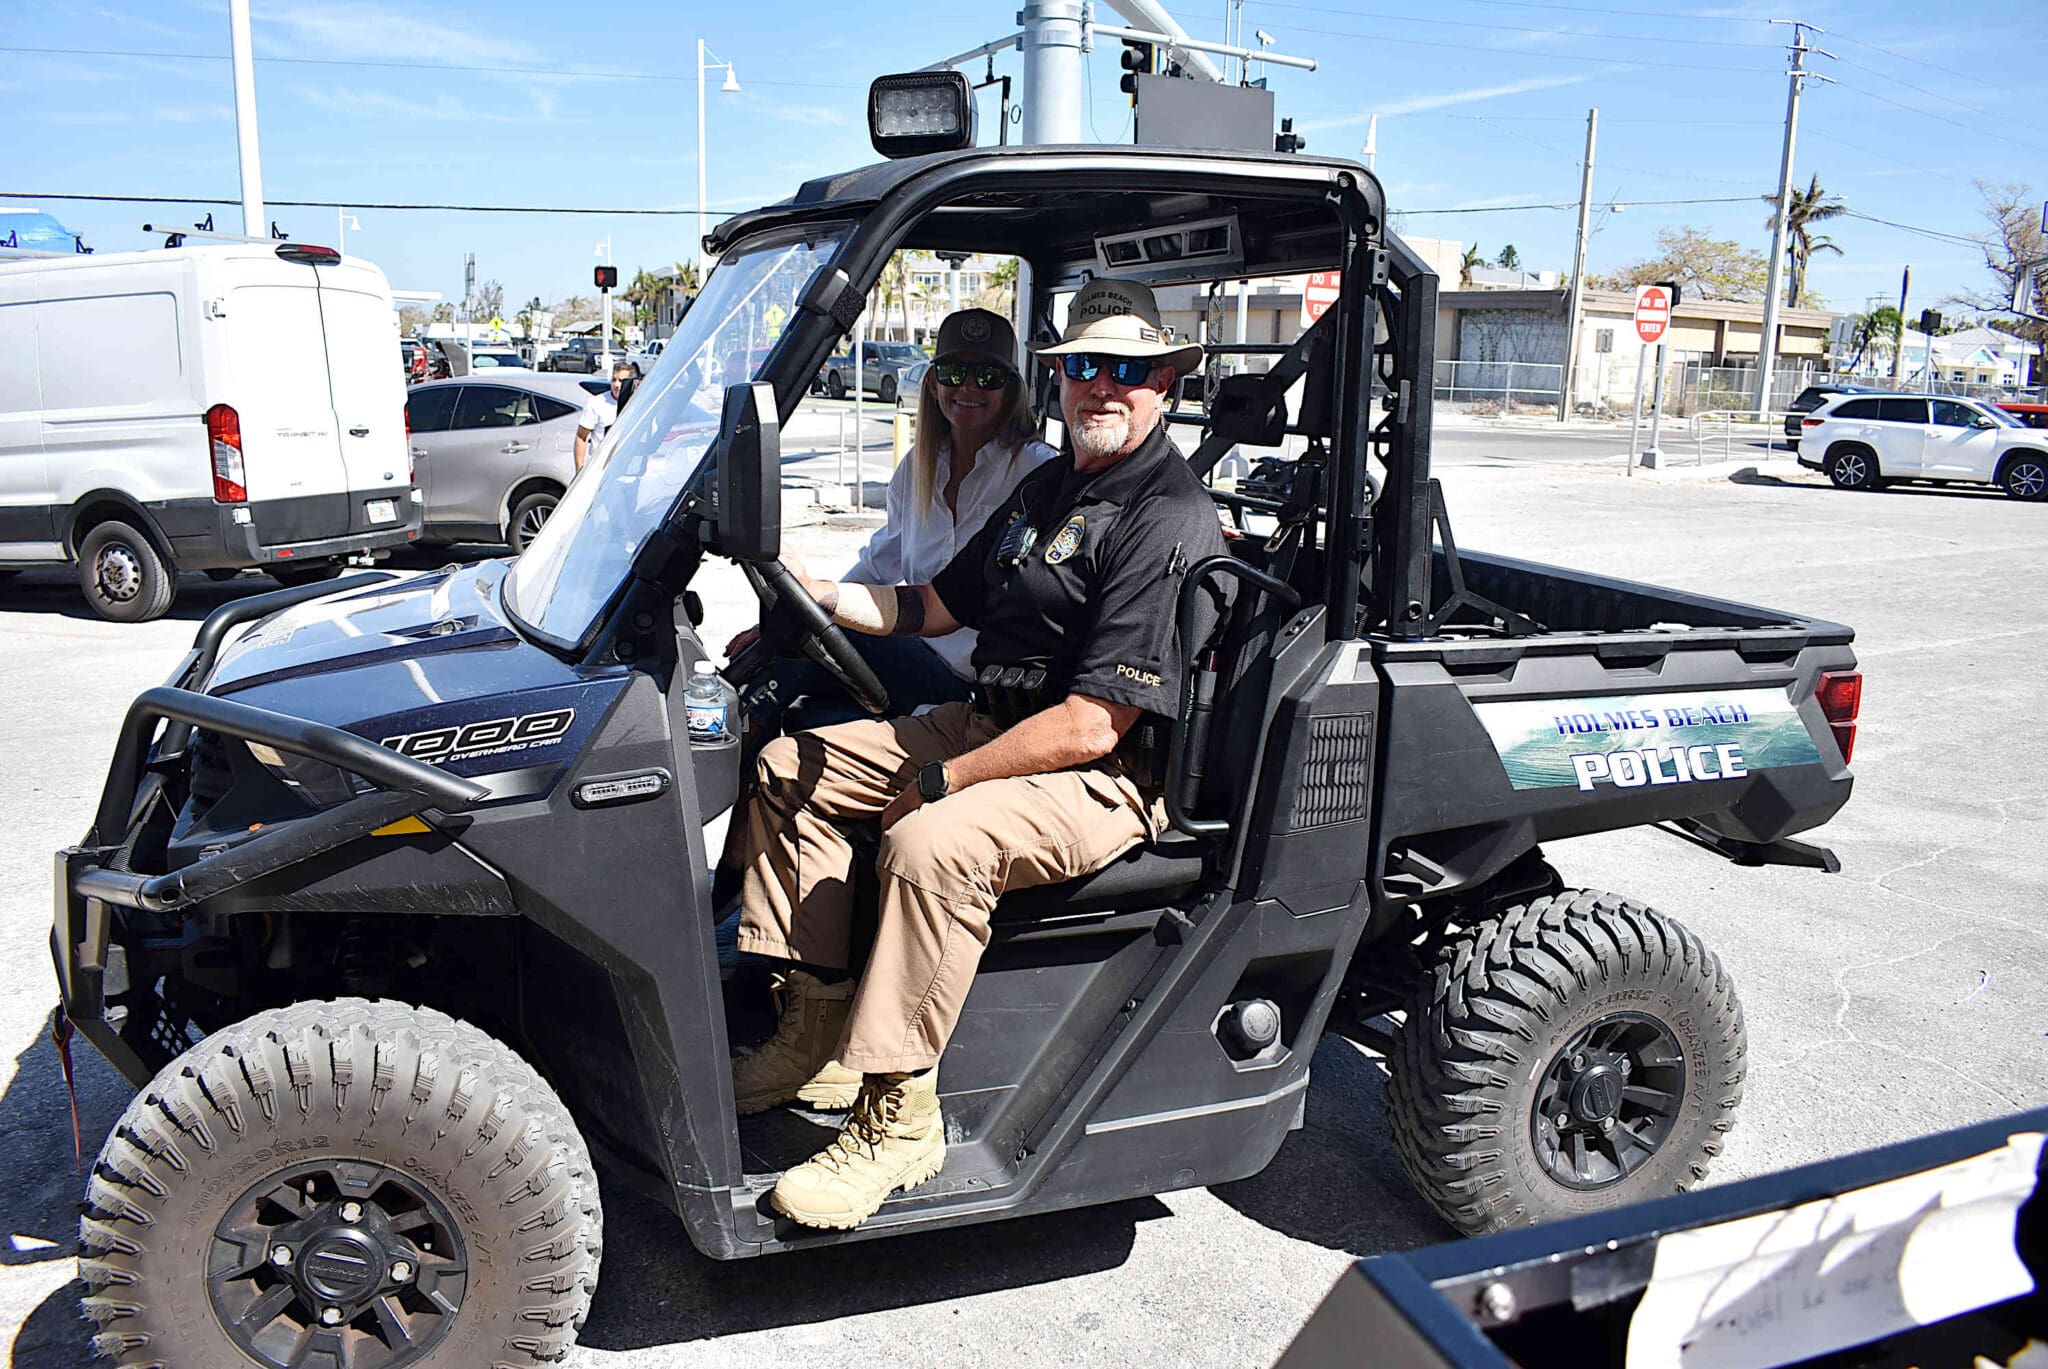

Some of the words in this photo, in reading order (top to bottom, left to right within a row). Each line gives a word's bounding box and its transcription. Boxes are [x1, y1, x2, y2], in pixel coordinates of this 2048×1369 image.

[1312, 273, 1325, 286] DO
[1080, 303, 1132, 319] POLICE
[1108, 292, 1133, 307] BEACH
[1641, 297, 1651, 308] DO
[1654, 298, 1666, 309] NOT
[1640, 322, 1662, 334] ENTER
[1116, 663, 1162, 687] POLICE
[1553, 708, 1660, 735] HOLMES
[1663, 703, 1749, 728] BEACH
[450, 743, 527, 762] OVERHEAD
[529, 736, 563, 749] CAM
[1568, 741, 1749, 793] POLICE
[1678, 1017, 1707, 1077] OHANZEE
[403, 1156, 479, 1225] OHANZEE
